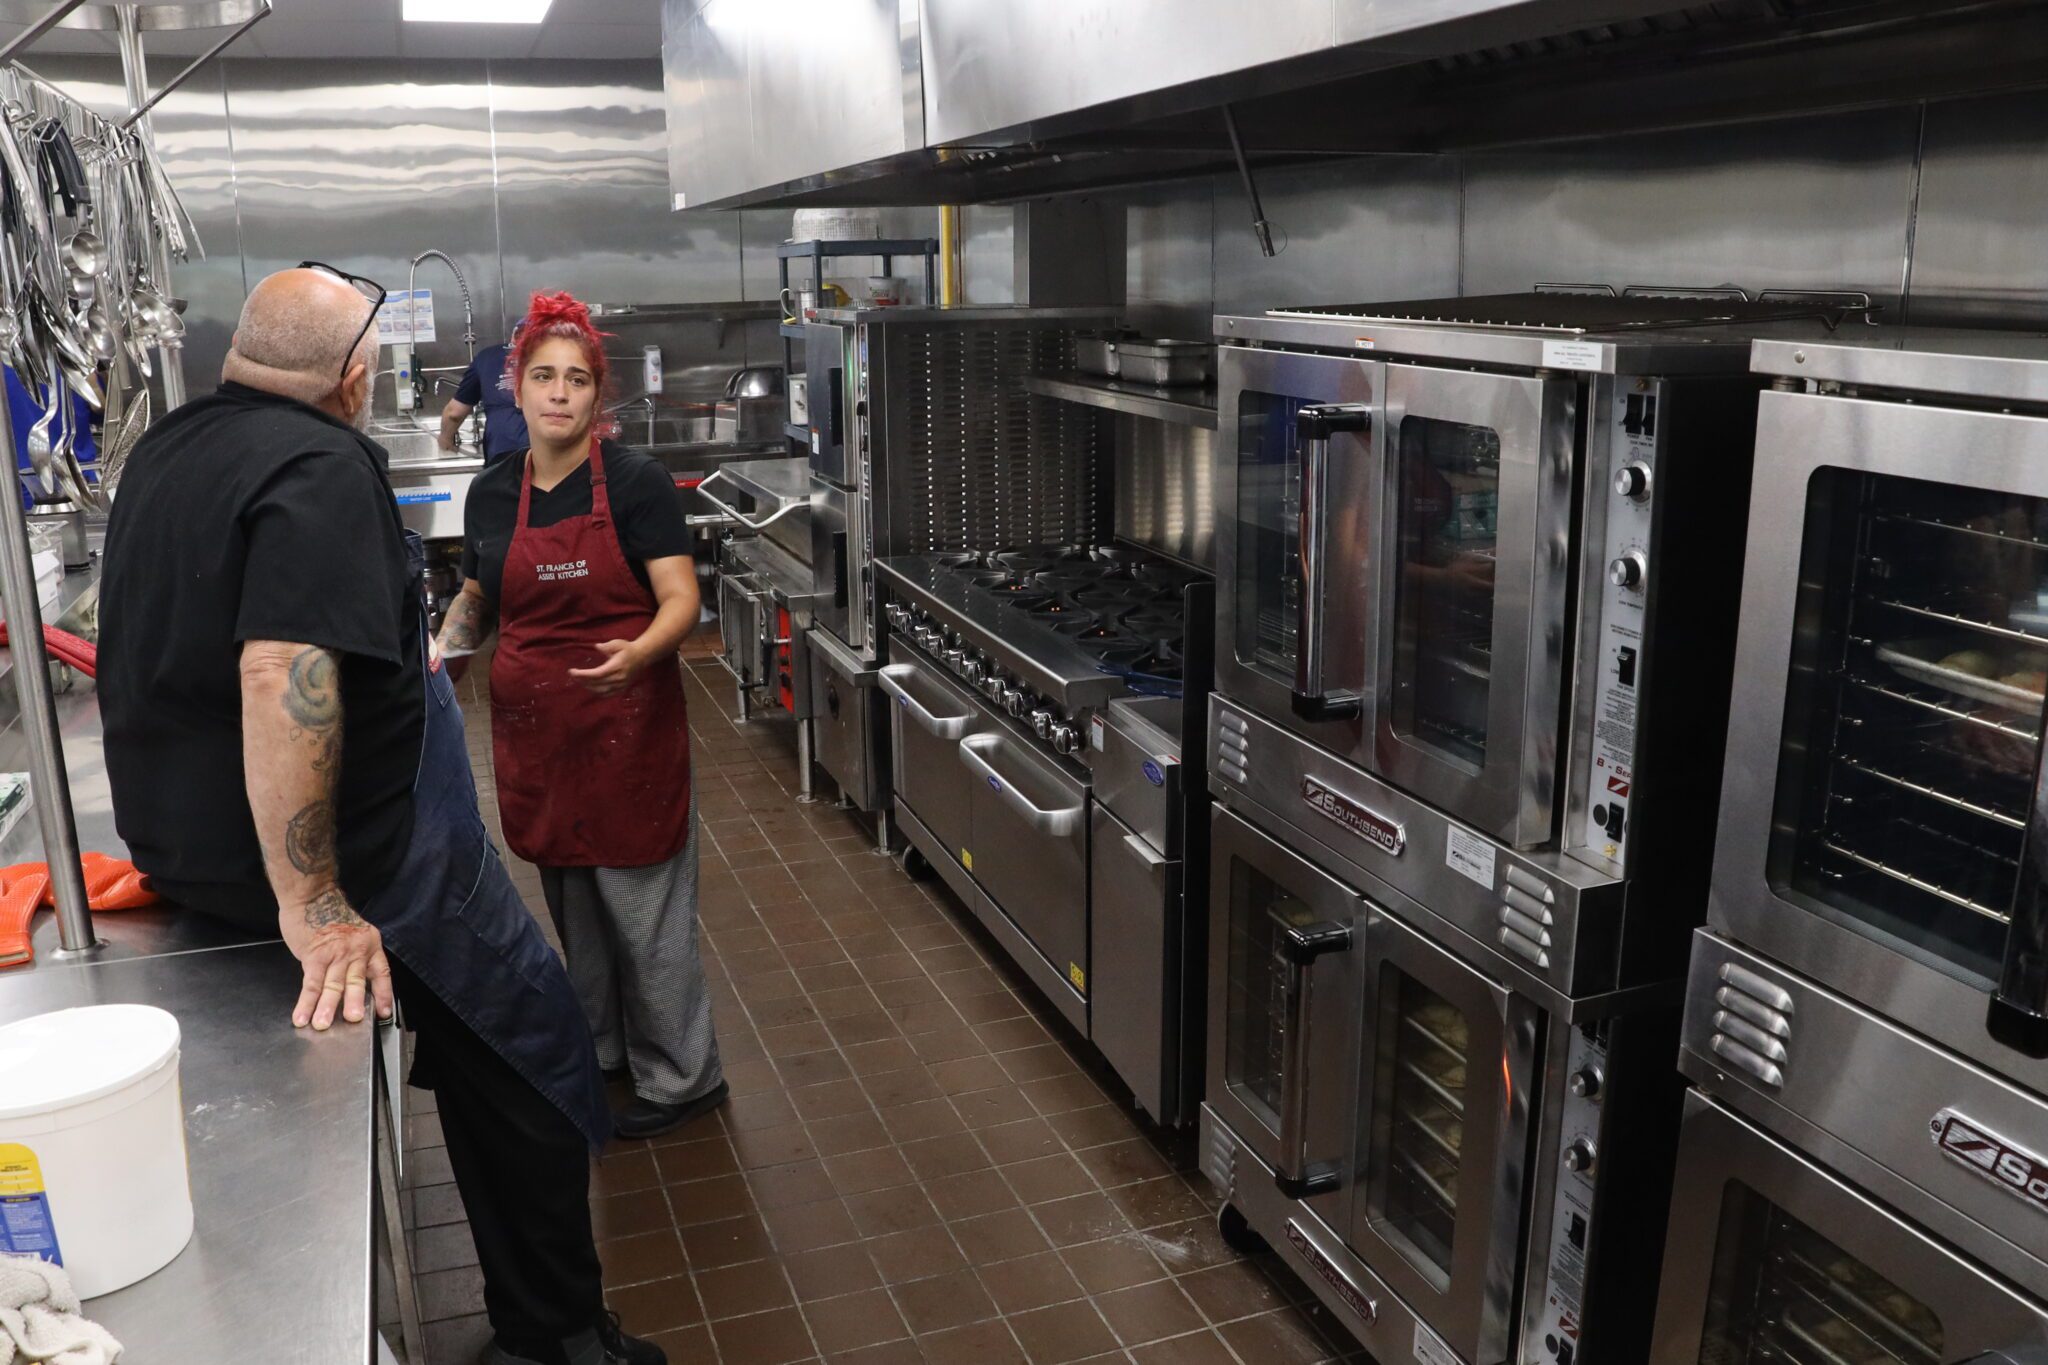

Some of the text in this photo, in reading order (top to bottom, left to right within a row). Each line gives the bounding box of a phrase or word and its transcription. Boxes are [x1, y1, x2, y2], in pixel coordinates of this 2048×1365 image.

[536, 559, 587, 573] ST. FRANCIS OF
[557, 568, 589, 580] KITCHEN
[1322, 793, 1395, 848] SOUTHBEND
[1304, 1243, 1369, 1317] SOUTHBEND
